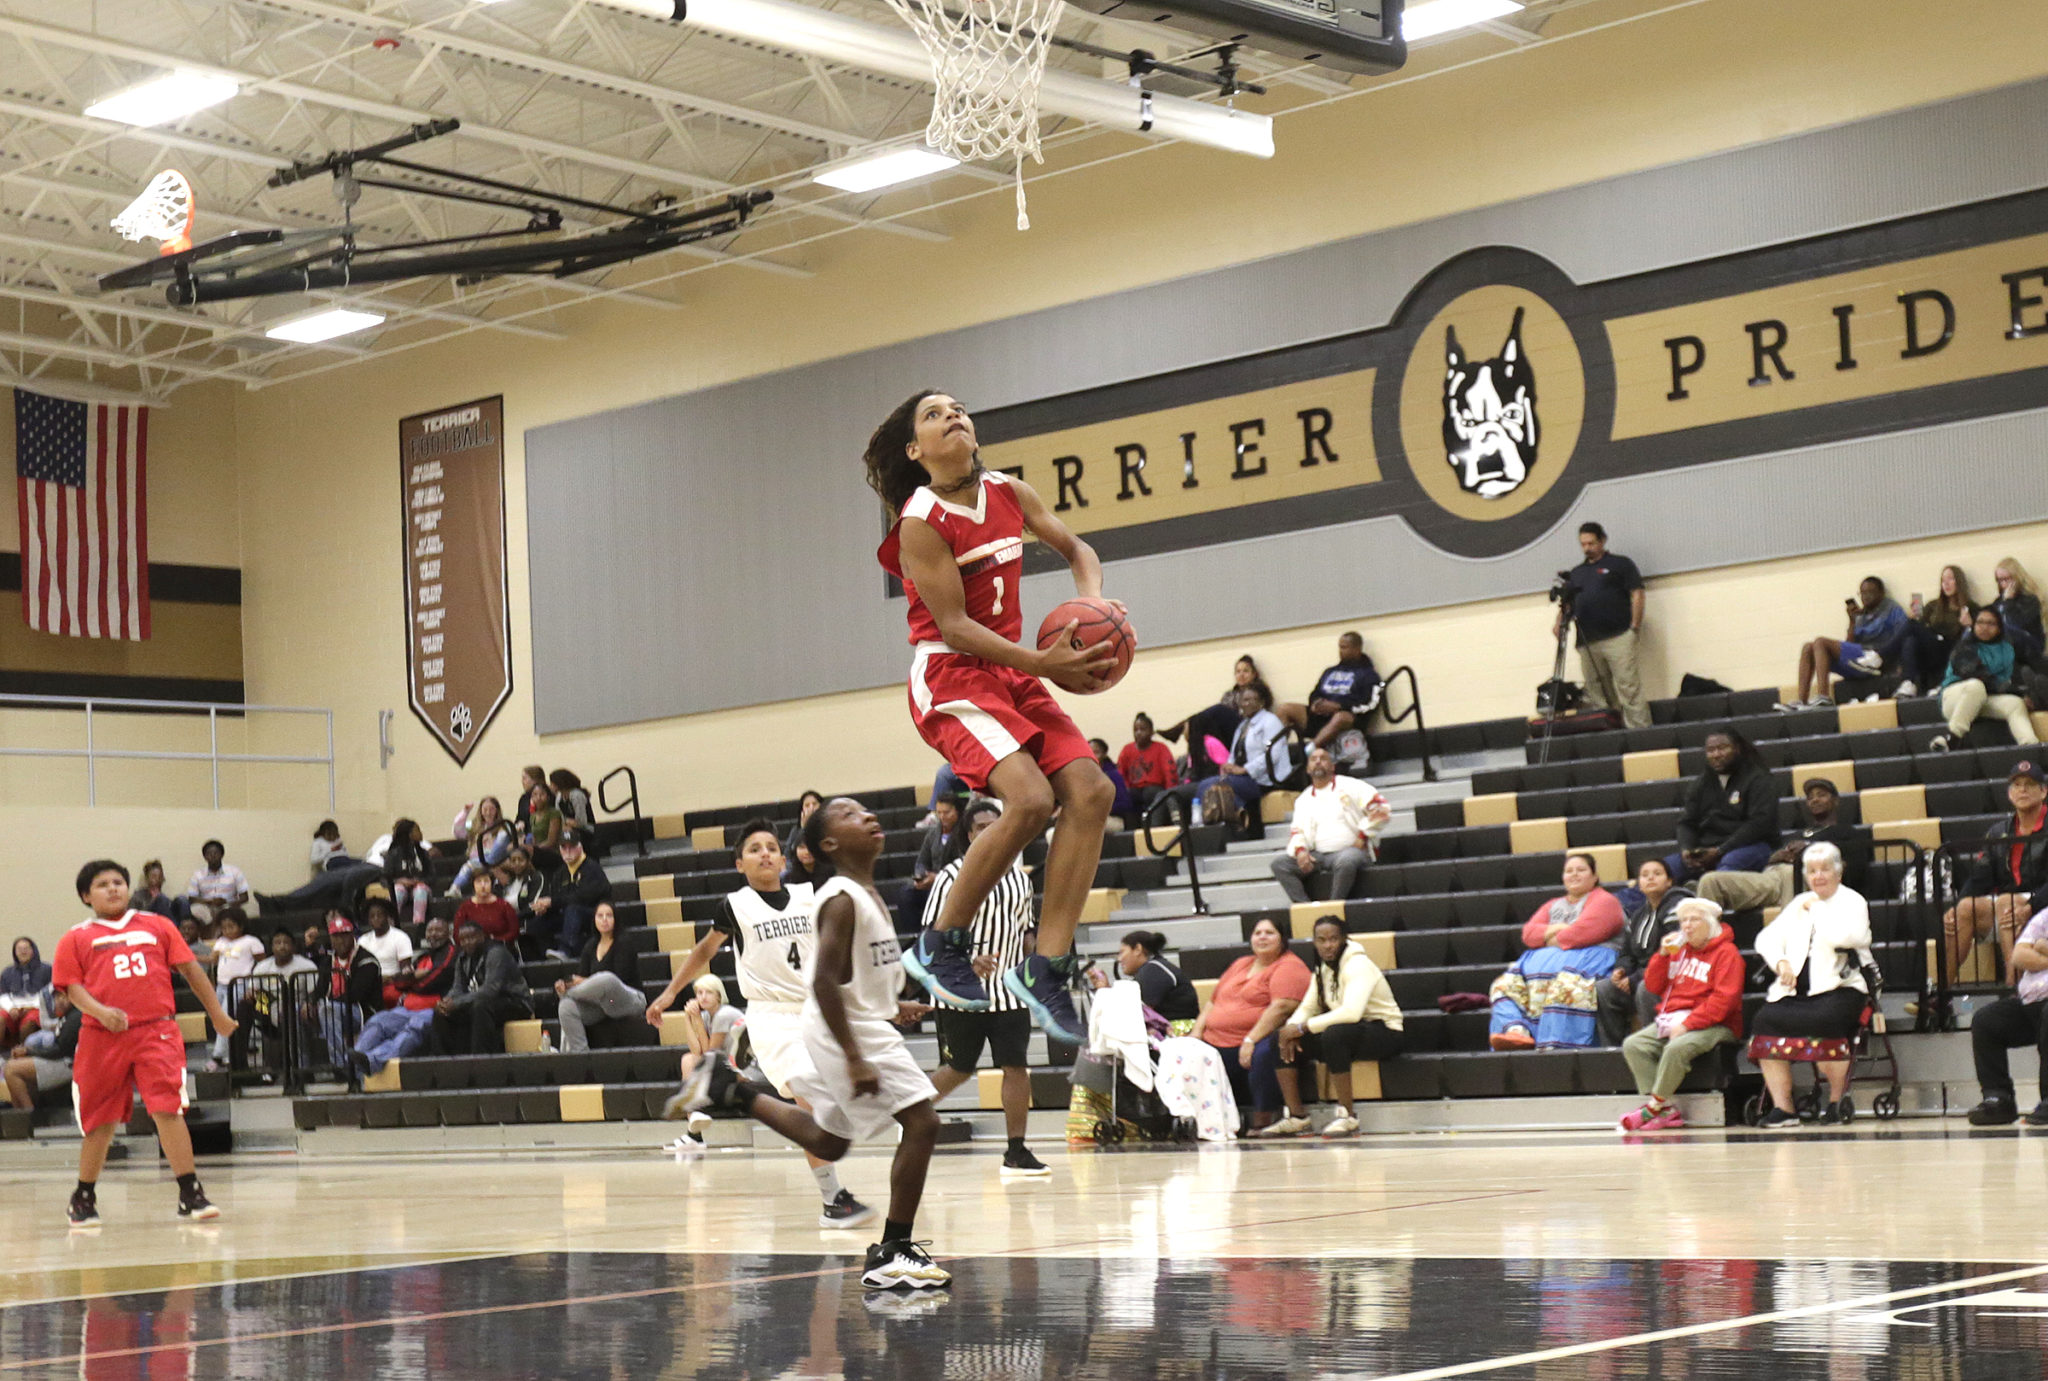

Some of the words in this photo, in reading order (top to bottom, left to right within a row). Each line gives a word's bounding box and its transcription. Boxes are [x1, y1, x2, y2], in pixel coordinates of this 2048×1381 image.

[1663, 266, 2048, 401] PRIDE
[422, 407, 480, 434] TERRIER
[410, 420, 494, 461] FOOTBALL
[992, 576, 1005, 616] 1
[113, 951, 148, 979] 23
[787, 942, 801, 970] 4
